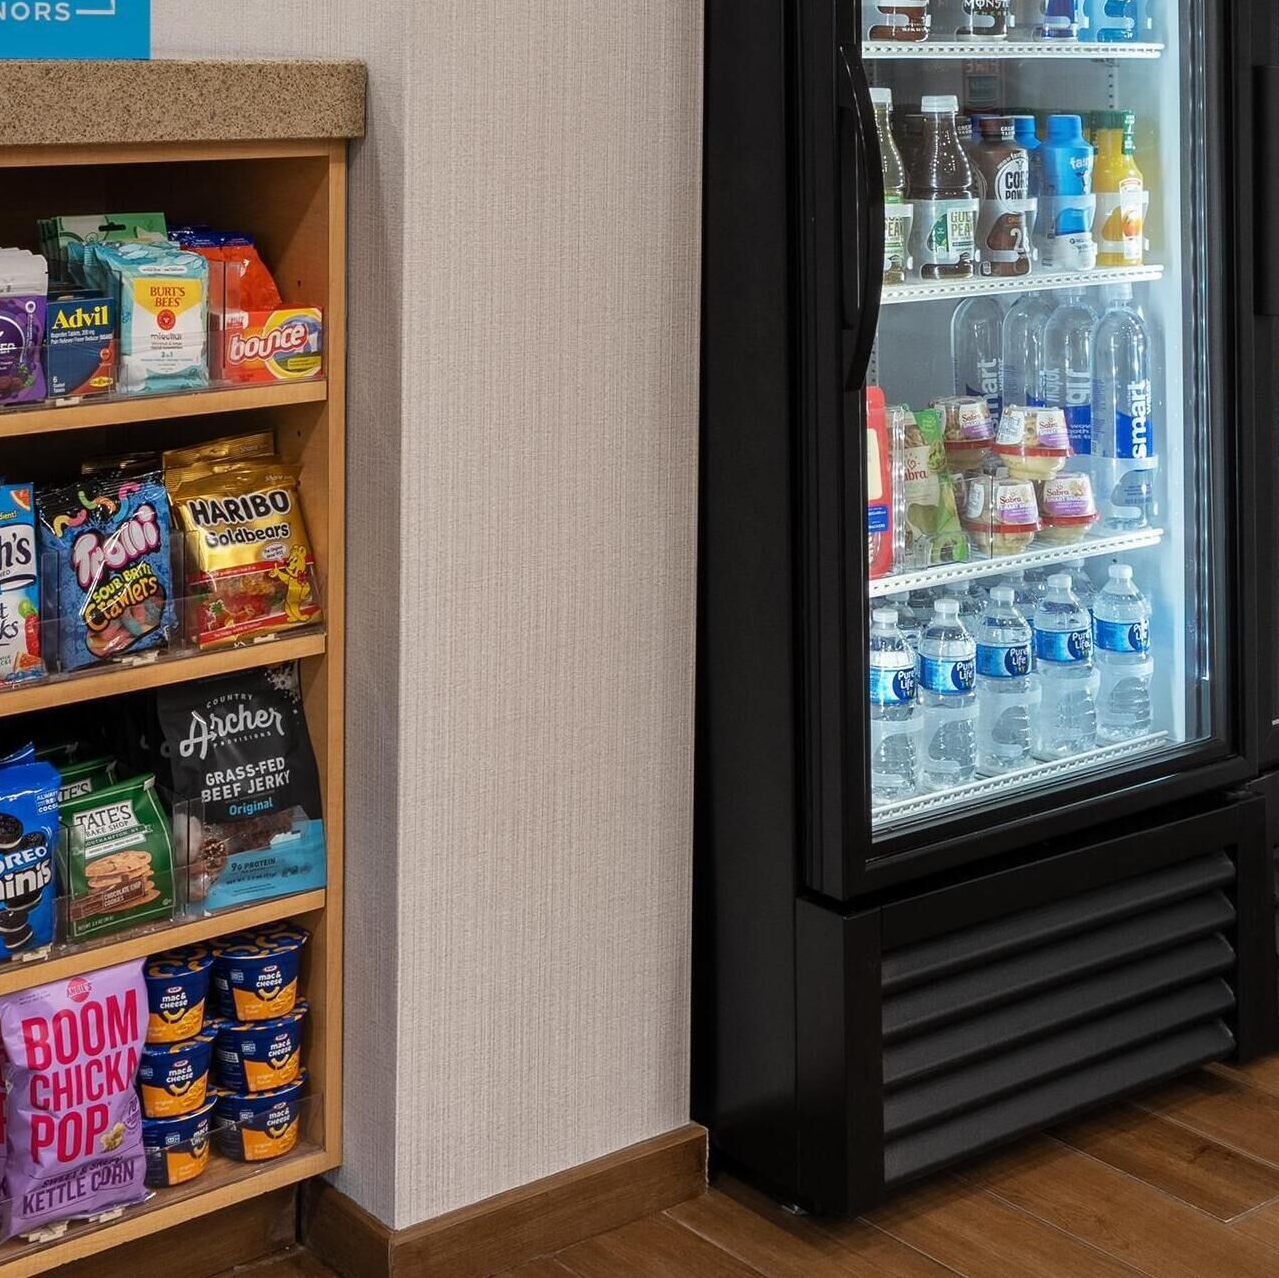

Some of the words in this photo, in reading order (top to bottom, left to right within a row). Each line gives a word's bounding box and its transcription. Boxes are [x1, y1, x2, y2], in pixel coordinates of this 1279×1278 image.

[150, 286, 186, 297] BURT'S
[155, 297, 180, 307] BEES
[52, 306, 109, 329] Advil
[227, 323, 309, 365] bounce
[188, 491, 290, 526] HARIBO
[74, 504, 158, 587] Trolli
[206, 522, 289, 548] Goldbears
[85, 575, 158, 631] Crawlers
[93, 578, 121, 602] SOUR
[206, 693, 253, 708] COUNTRY
[179, 704, 285, 759] Archer
[213, 730, 272, 748] PROVISIONS
[206, 757, 285, 786] GRASS-FED
[201, 785, 242, 803] BEEF
[247, 770, 290, 793] JERKY
[76, 805, 132, 829] TATE'S
[229, 797, 273, 816] Original
[109, 821, 129, 832] SHOP
[21, 988, 139, 1071] BOOM
[29, 1047, 138, 1111] CHICKA
[31, 1103, 110, 1165] POP
[23, 1176, 87, 1216] KETTLE
[92, 1160, 135, 1193] CORN
